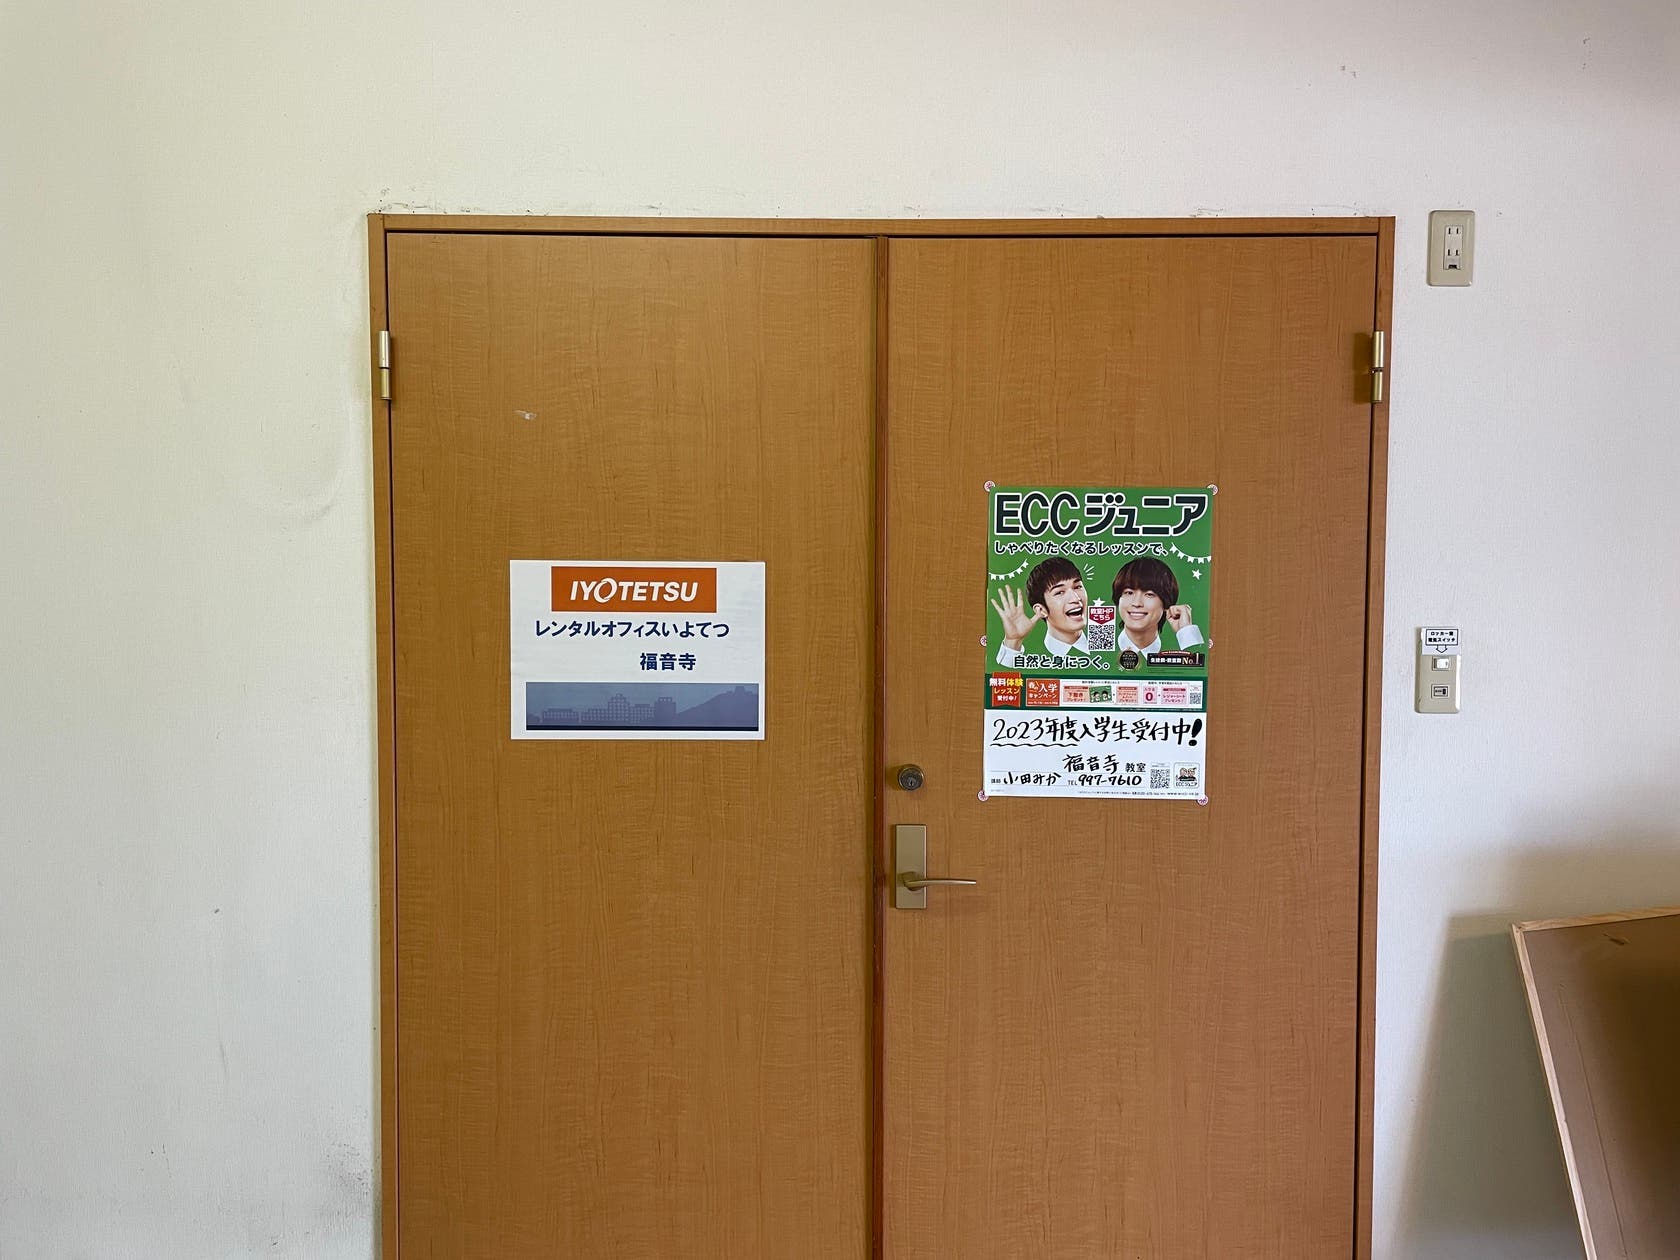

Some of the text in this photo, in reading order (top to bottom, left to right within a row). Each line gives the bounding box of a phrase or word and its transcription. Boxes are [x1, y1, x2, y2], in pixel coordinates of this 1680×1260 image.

[995, 491, 1208, 537] ECCジュニア
[995, 541, 1169, 556] しゃべりたくなるレッスンで、
[570, 577, 699, 603] IYOTETSU
[535, 620, 730, 638] レンタルオフィスいよてつ
[639, 652, 697, 671] 福音寺
[1013, 655, 1111, 671] 自然と身につく。
[994, 687, 1021, 695] レッスン
[992, 716, 1203, 747] 2023年度入学生受付中!
[1062, 753, 1147, 774] 福音寺 教室
[1003, 771, 1062, 787] 小田みか
[1078, 774, 1142, 787] 997-7610
